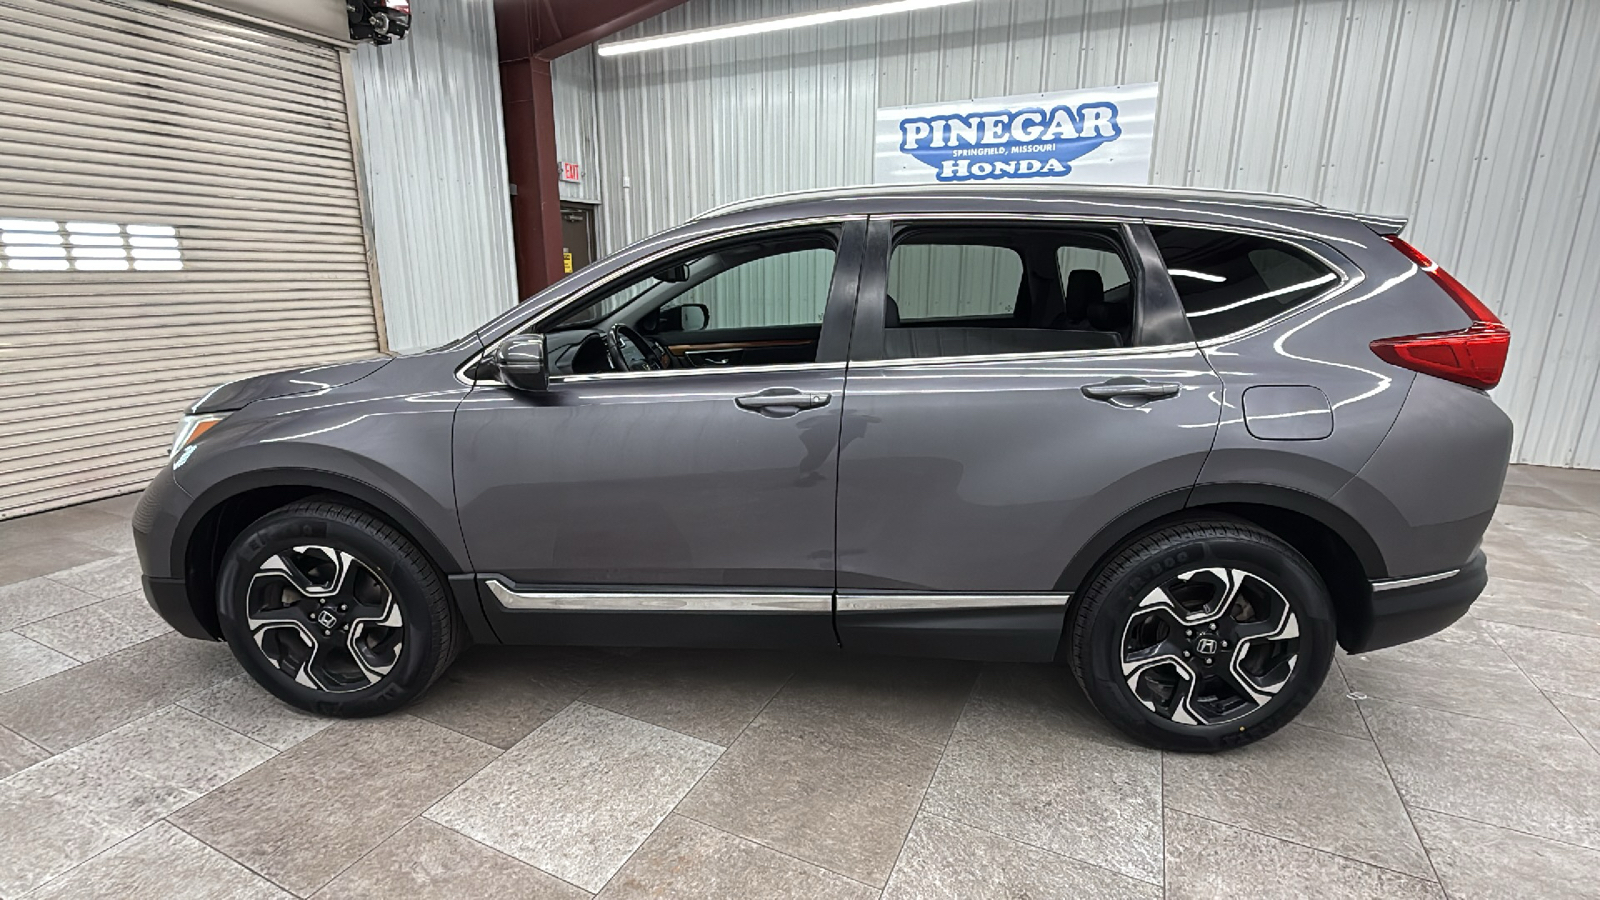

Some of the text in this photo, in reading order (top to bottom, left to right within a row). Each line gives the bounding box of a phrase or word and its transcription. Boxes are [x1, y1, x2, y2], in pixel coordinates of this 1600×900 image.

[904, 106, 1116, 149] PINEGAR
[952, 143, 1056, 157] SPRINGFIELD, MISSOURI
[565, 163, 579, 180] EXIT
